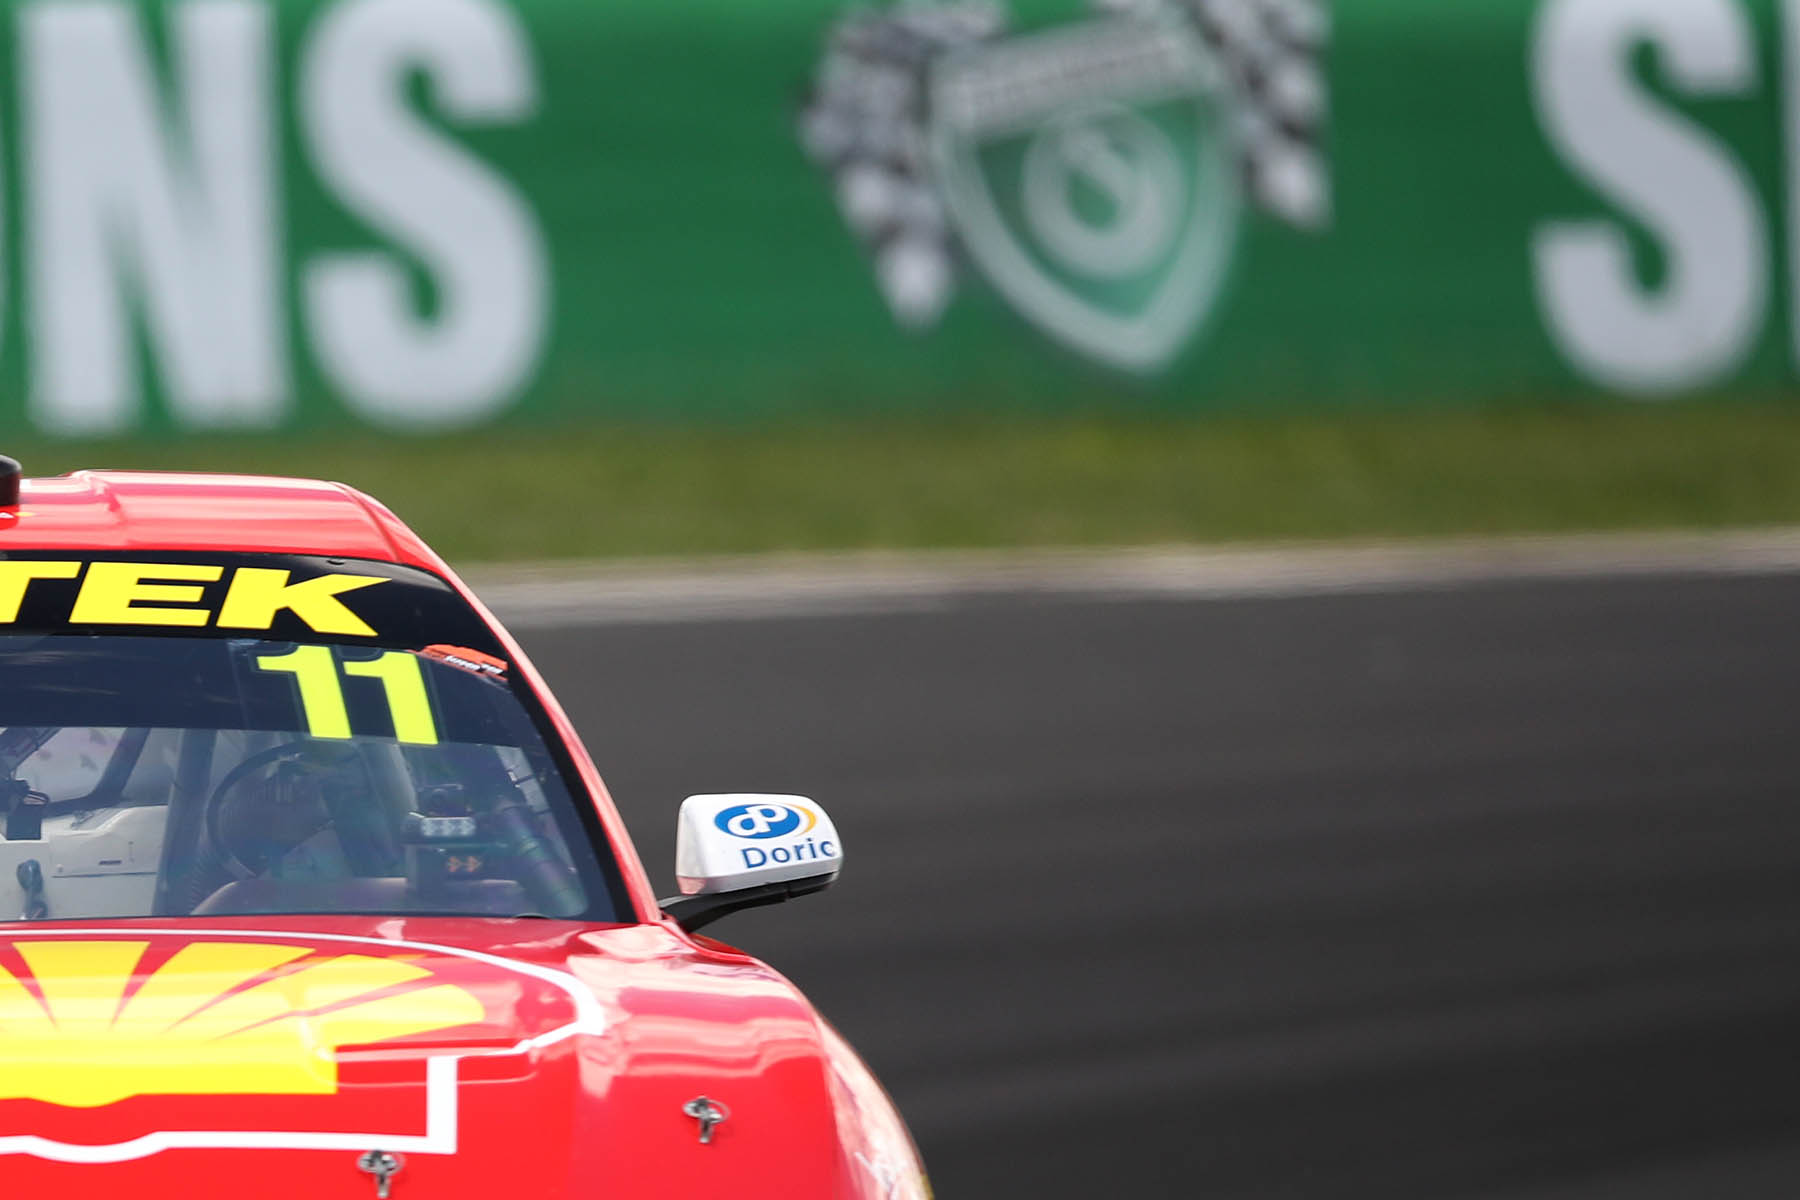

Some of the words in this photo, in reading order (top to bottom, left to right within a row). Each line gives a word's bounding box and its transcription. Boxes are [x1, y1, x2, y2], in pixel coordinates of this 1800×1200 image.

[1530, 0, 1800, 390] S
[256, 643, 439, 745] 11
[741, 837, 835, 869] Doric
